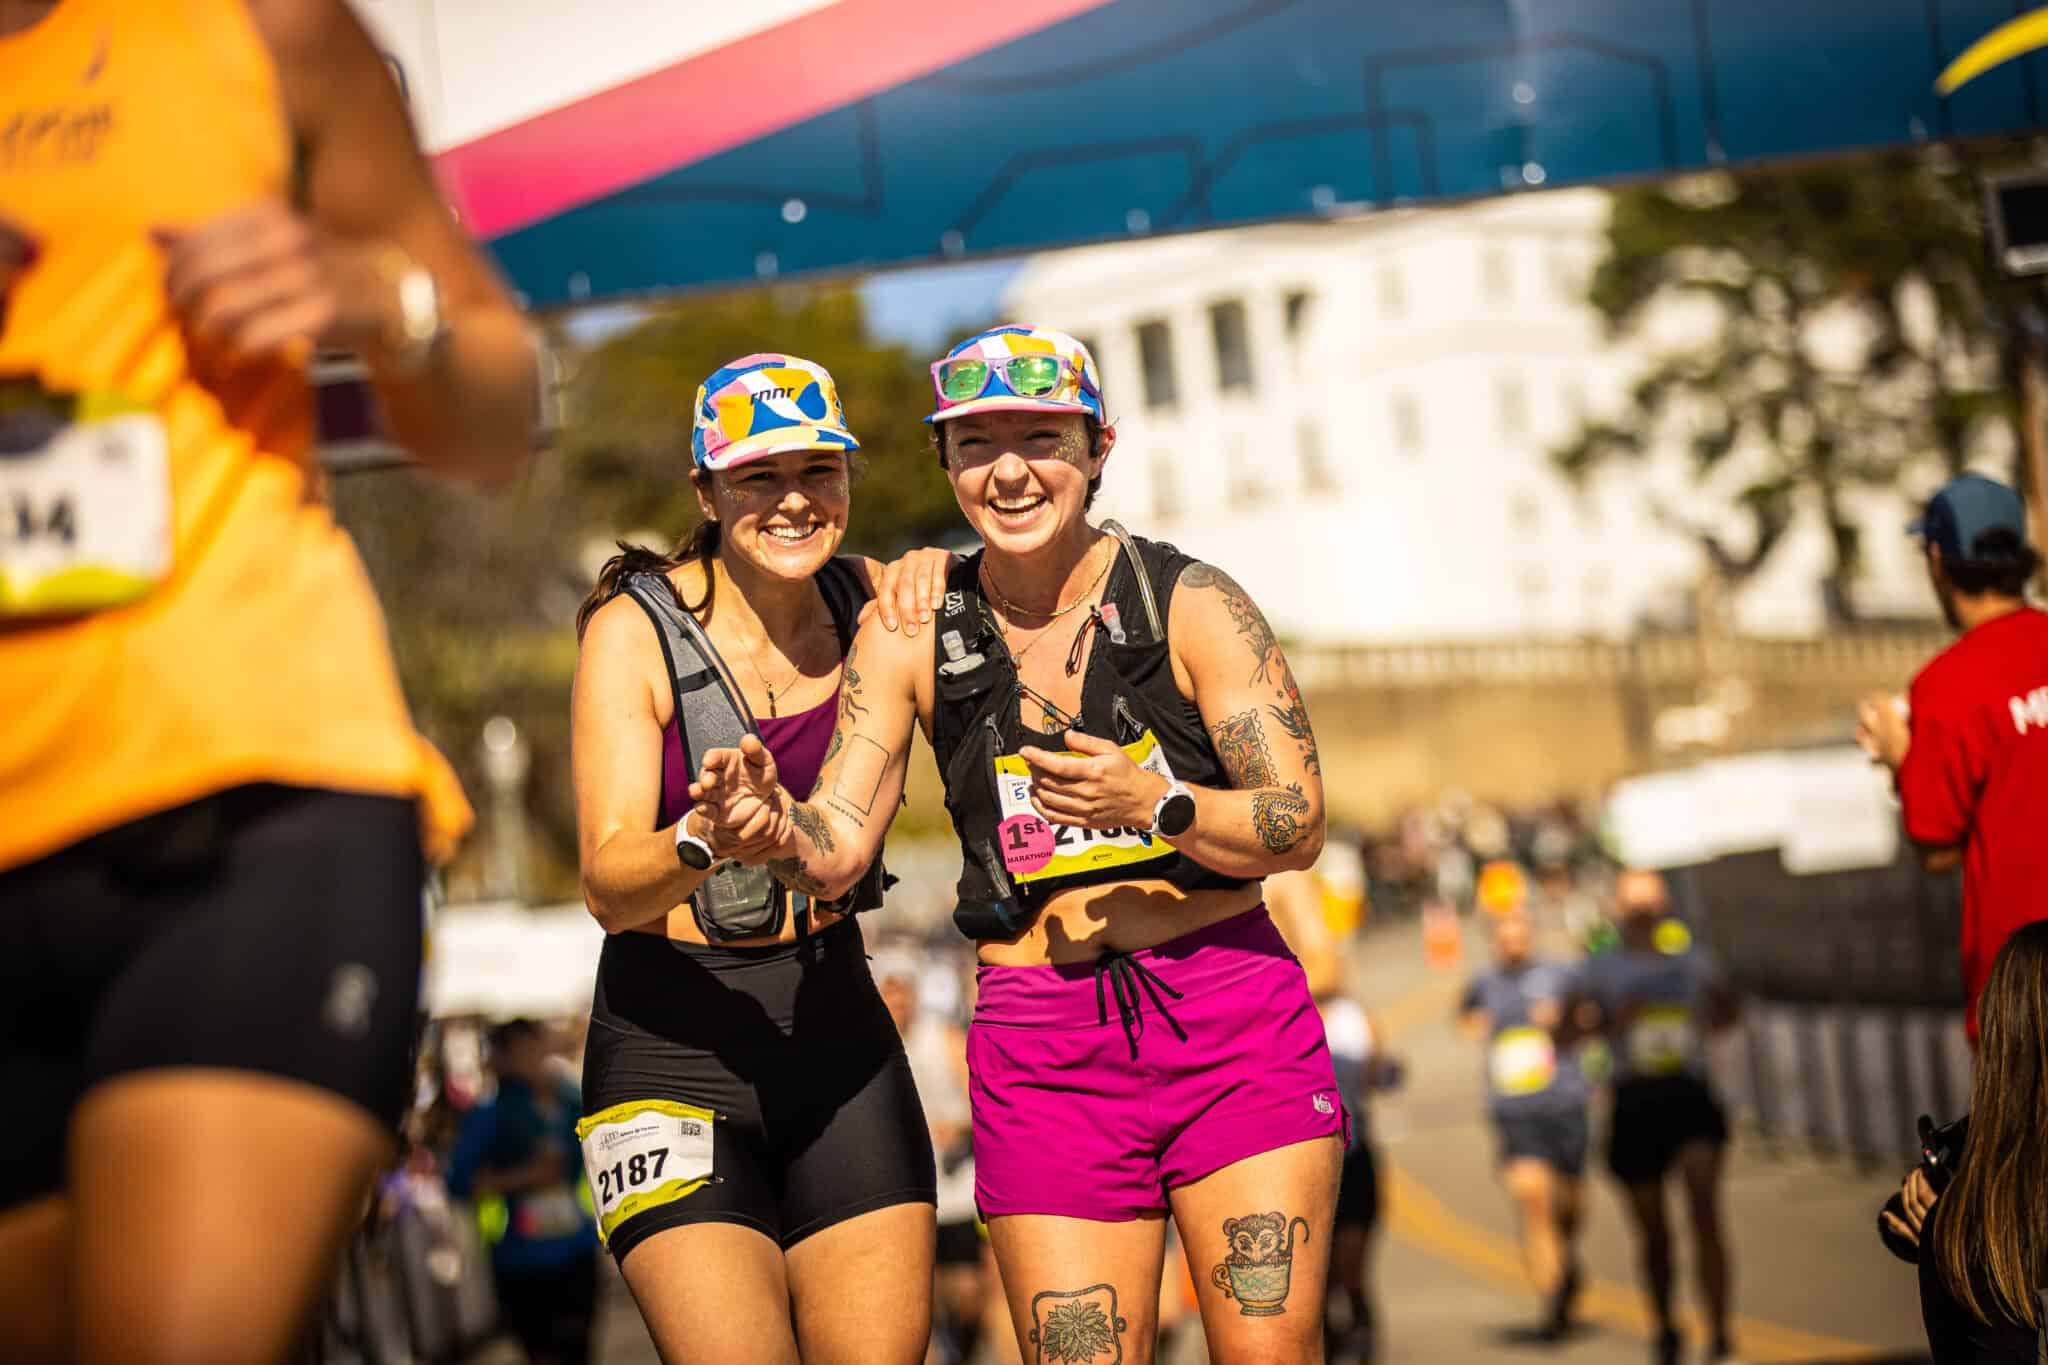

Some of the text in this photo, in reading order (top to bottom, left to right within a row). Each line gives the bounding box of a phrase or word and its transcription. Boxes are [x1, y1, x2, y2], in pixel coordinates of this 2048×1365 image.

[750, 387, 796, 407] rnnr
[1014, 786, 1025, 800] 5
[1007, 817, 1045, 850] 1st
[1007, 851, 1052, 864] MARATHON
[598, 1148, 669, 1205] 2187
